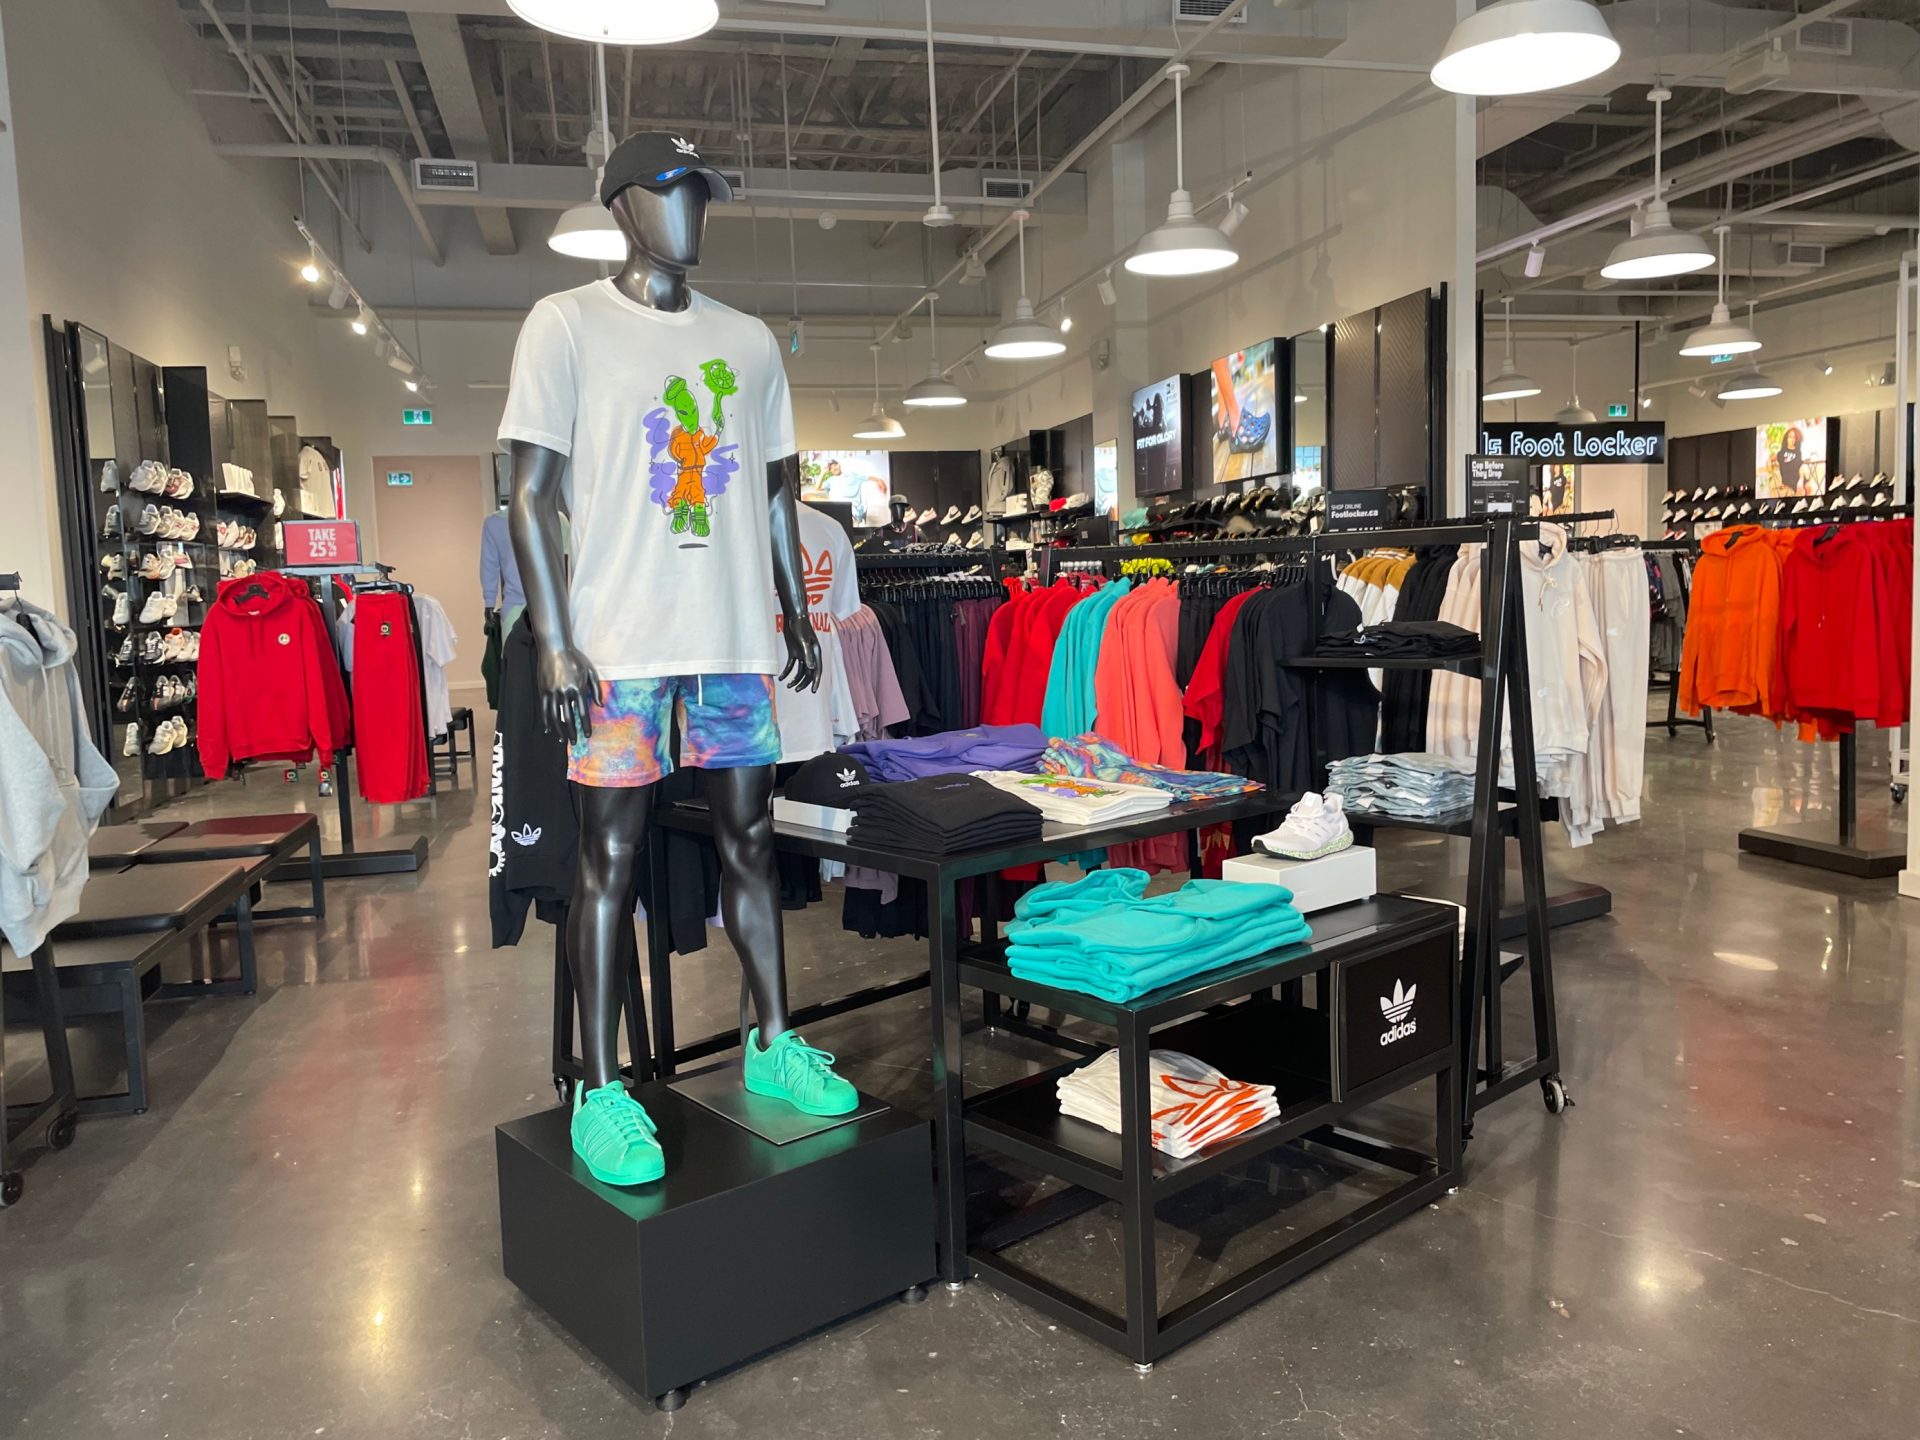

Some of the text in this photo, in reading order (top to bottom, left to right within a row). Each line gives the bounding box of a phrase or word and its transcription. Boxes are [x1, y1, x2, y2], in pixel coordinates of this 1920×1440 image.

[1145, 434, 1157, 447] FOR
[1157, 430, 1176, 443] GLORY
[1510, 431, 1566, 457] Foot
[1573, 430, 1658, 457] Locker
[1471, 461, 1504, 471] Cop Before
[1472, 469, 1502, 480] They Drop
[1331, 509, 1379, 518] Footlocker.ca
[307, 528, 337, 541] TAKE
[1380, 1020, 1417, 1047] adidas
